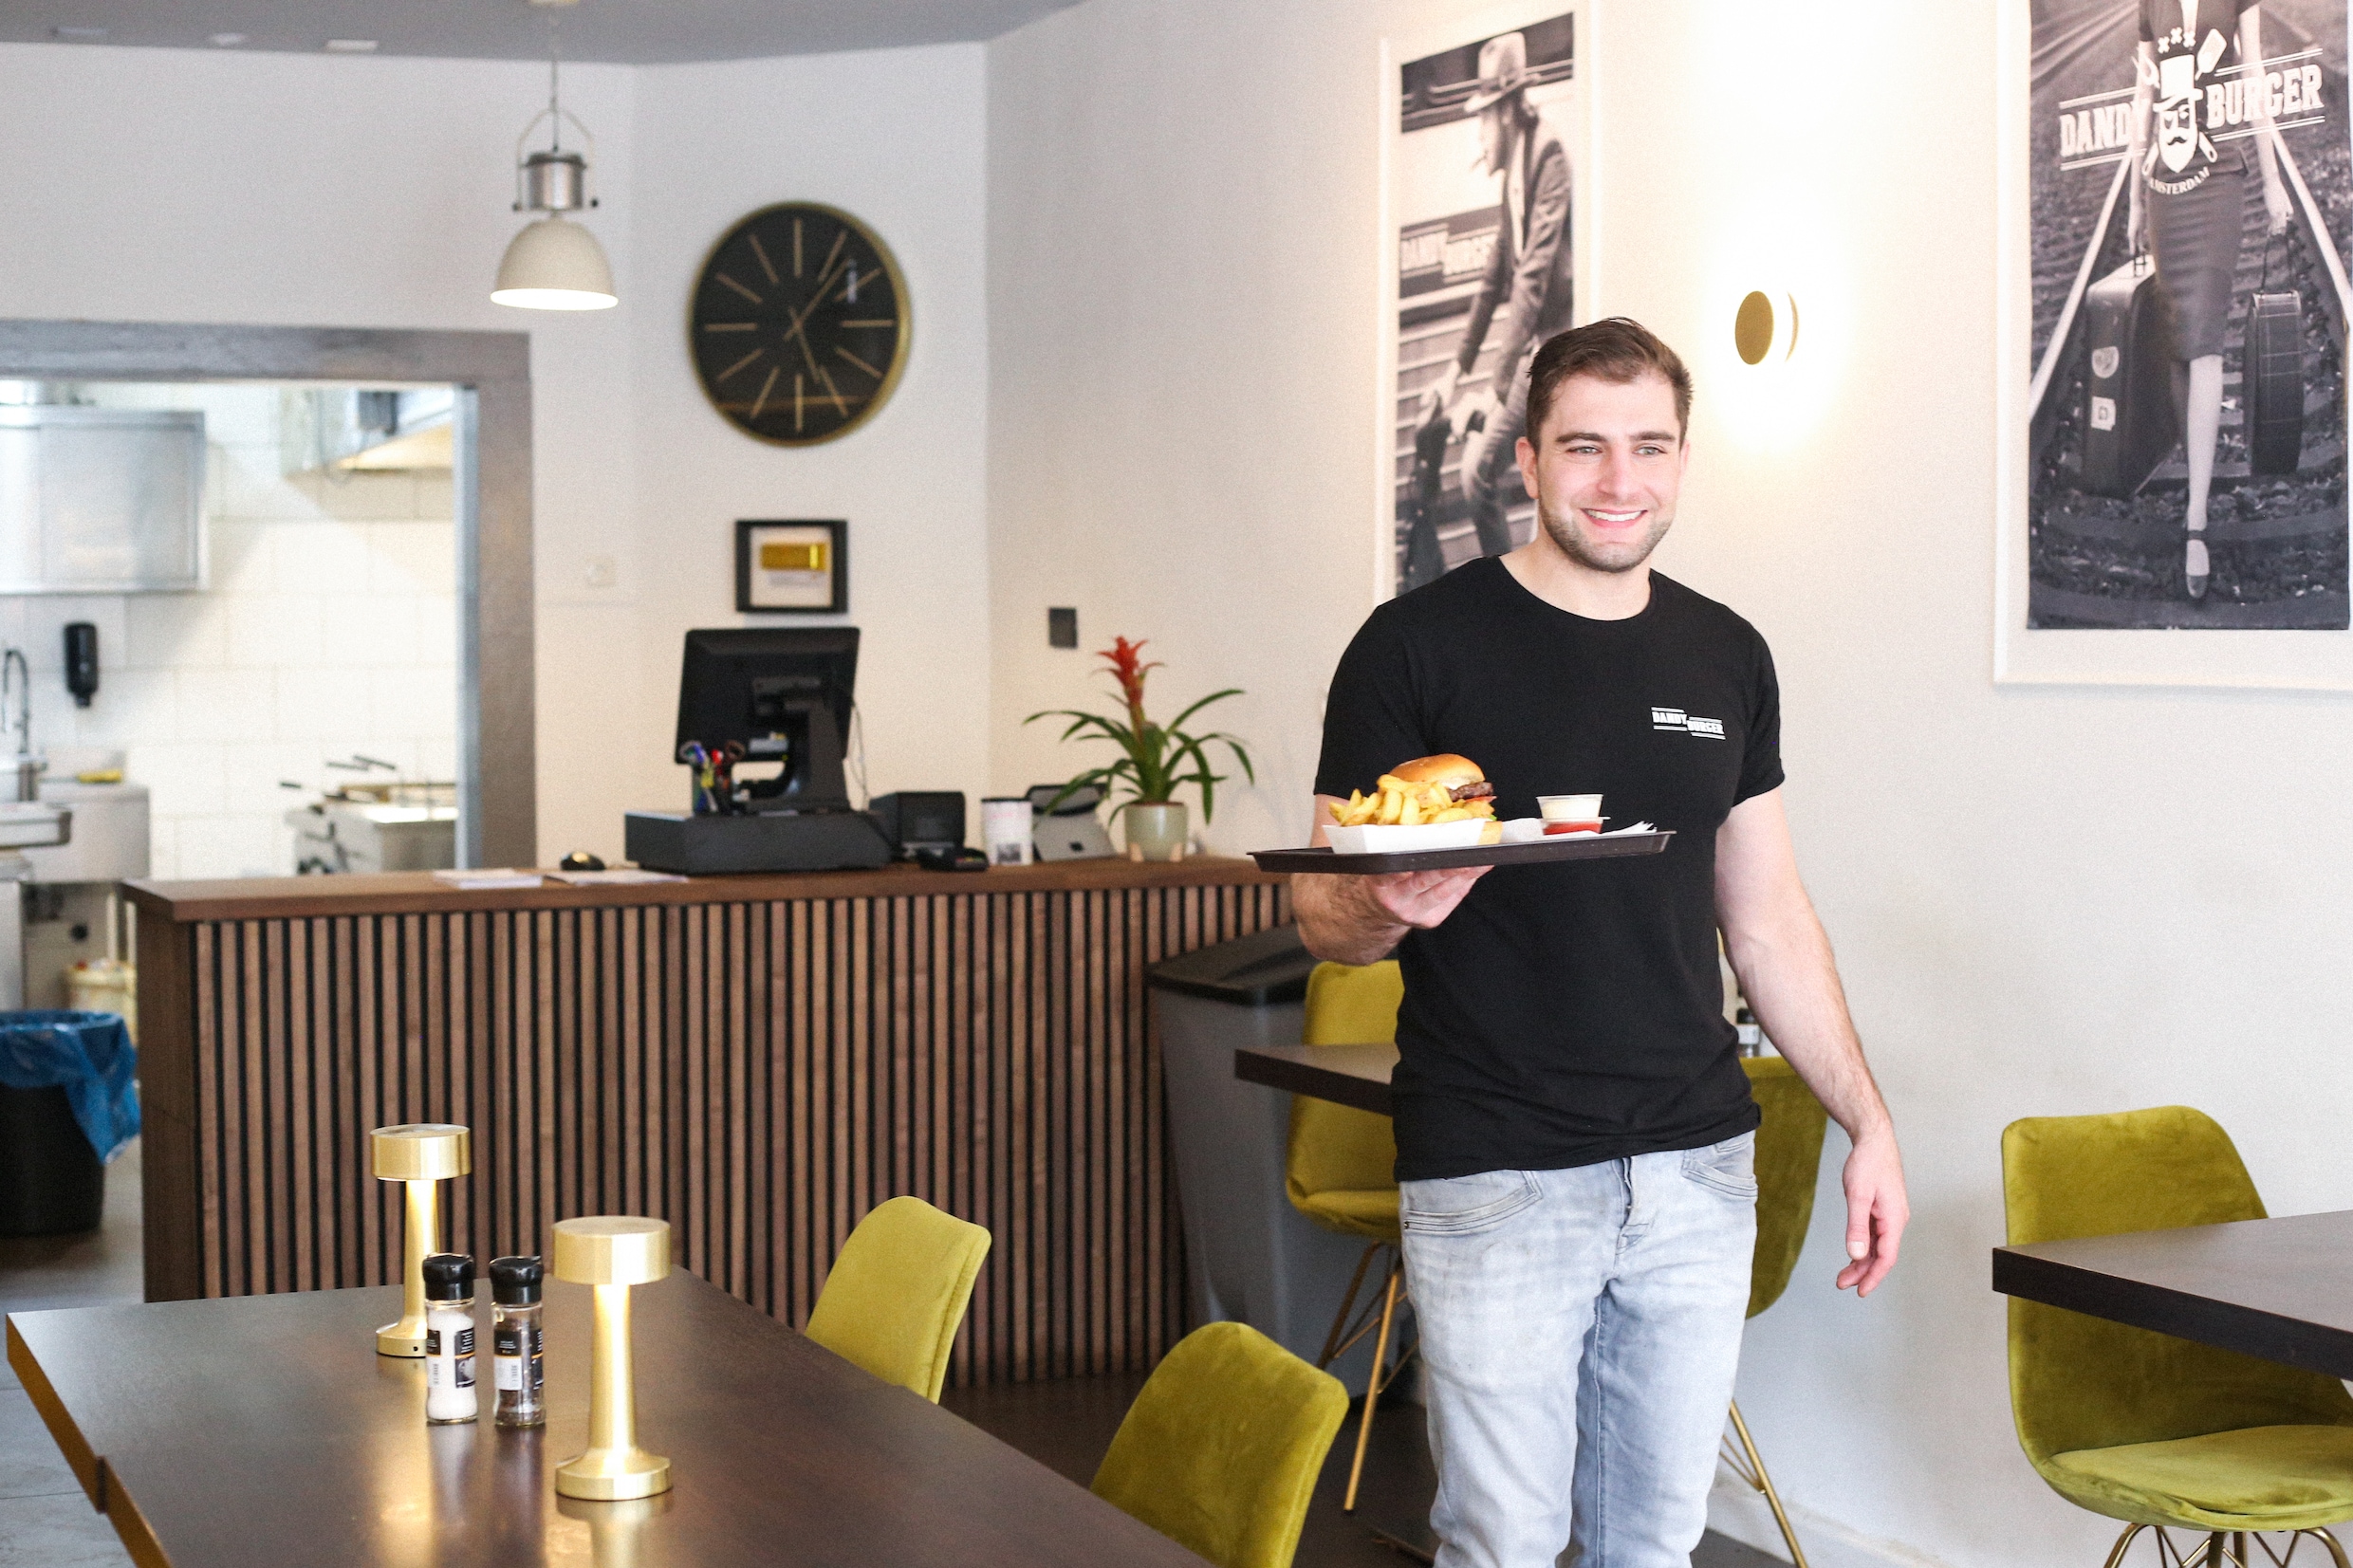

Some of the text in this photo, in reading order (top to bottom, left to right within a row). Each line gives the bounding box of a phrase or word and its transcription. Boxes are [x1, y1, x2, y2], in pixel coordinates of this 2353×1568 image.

[2059, 64, 2325, 157] DANDY BURGER
[2147, 166, 2210, 194] AMSTERDAM
[1652, 711, 1725, 734] DANDY BURGER
